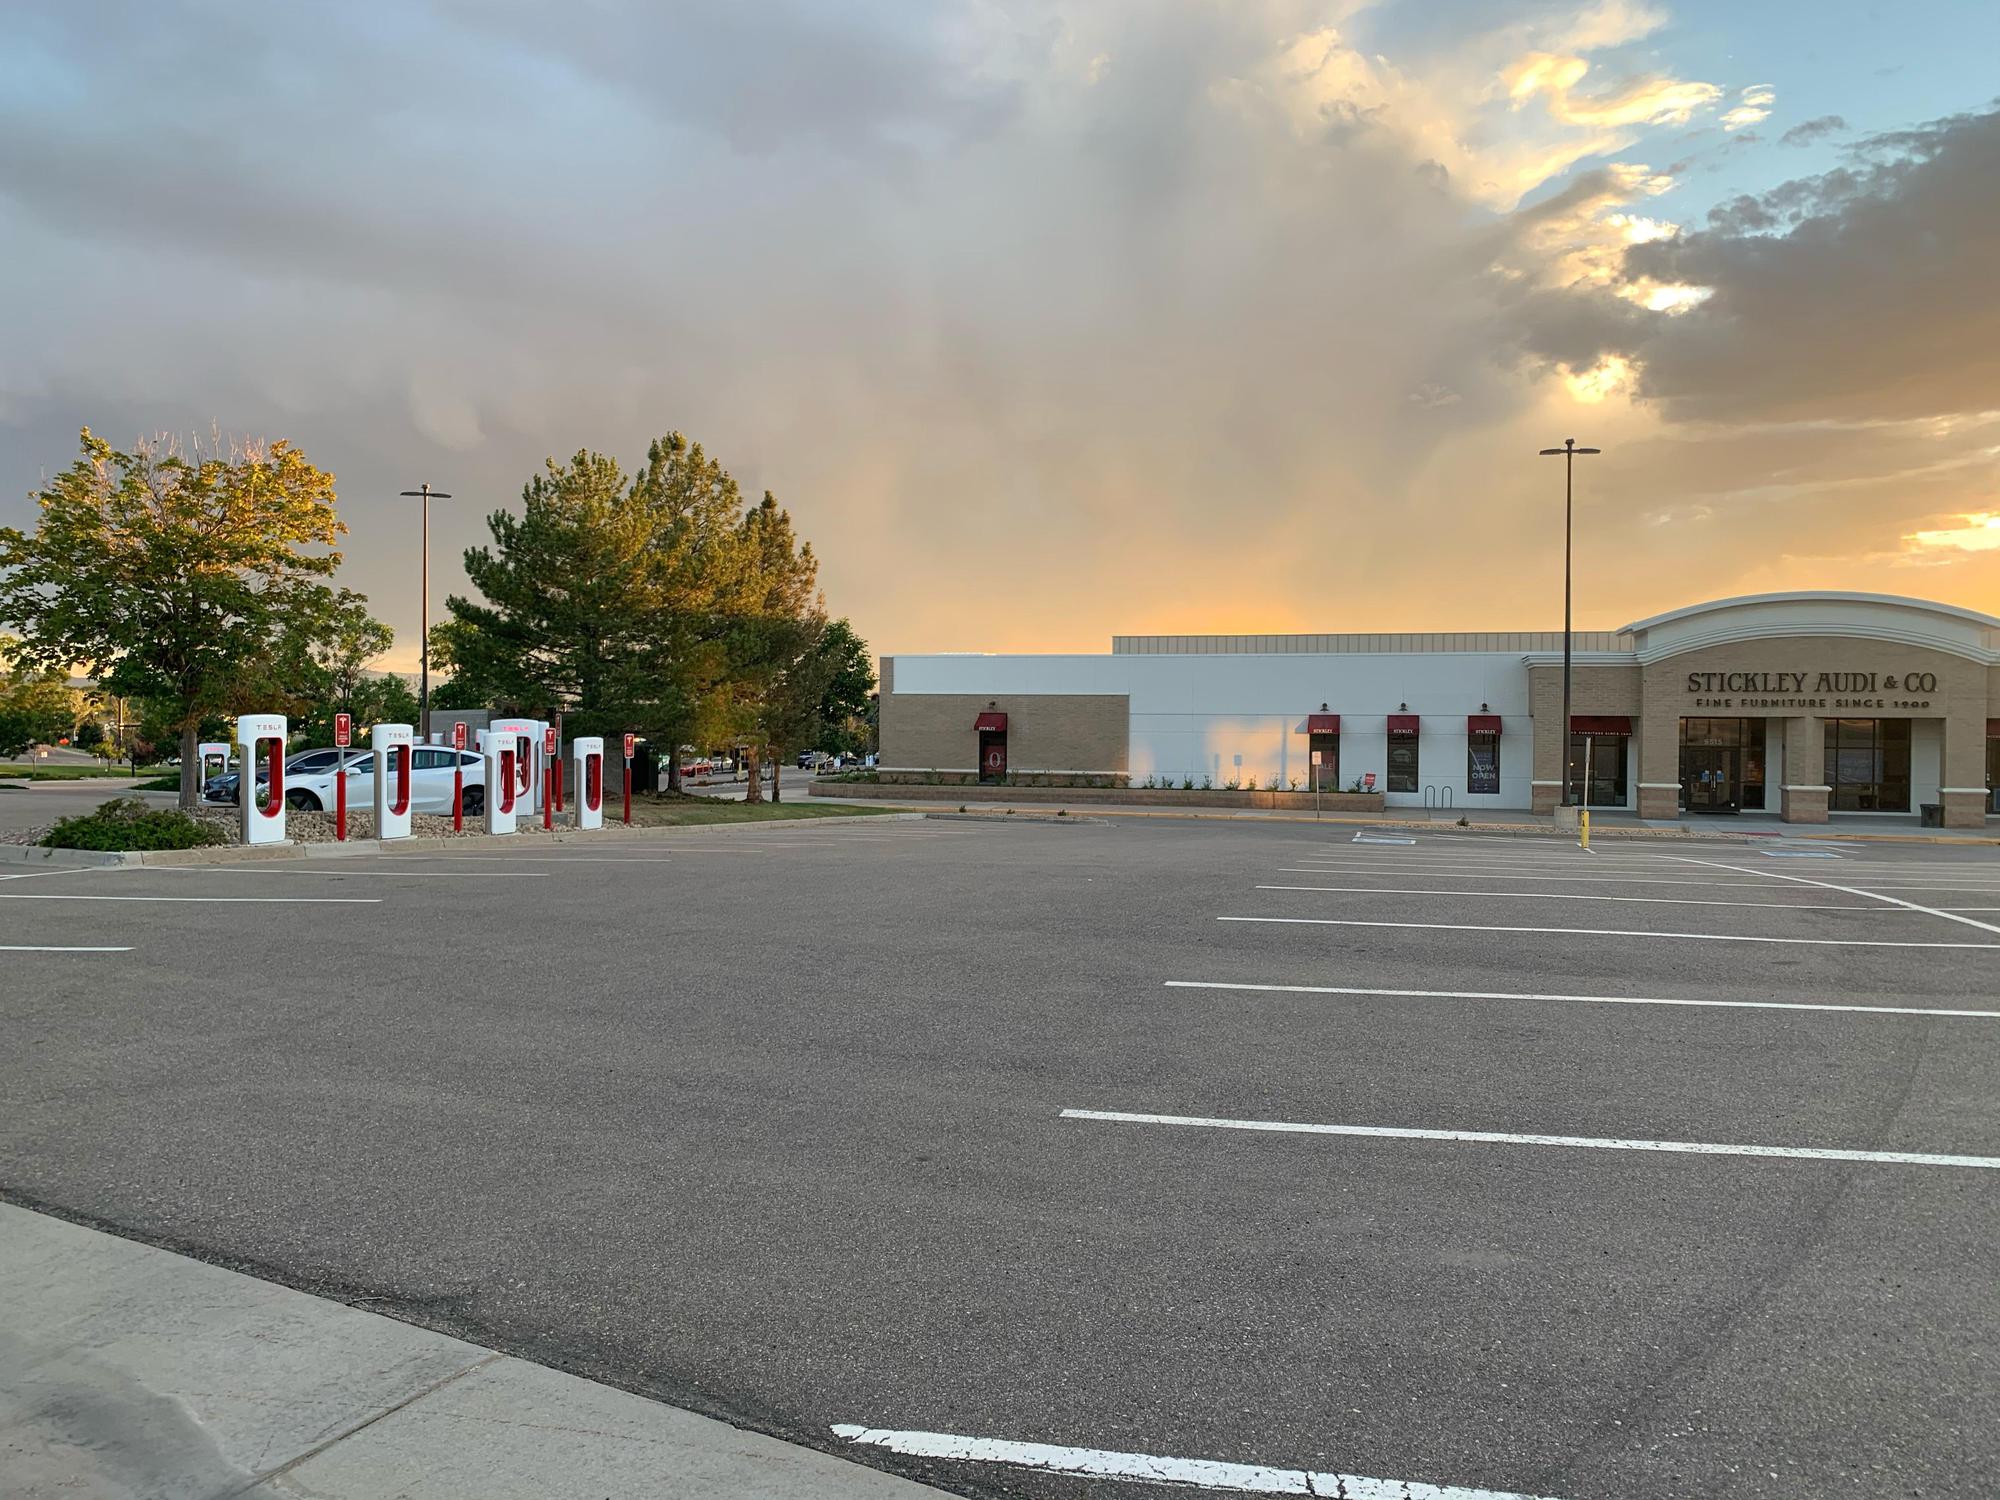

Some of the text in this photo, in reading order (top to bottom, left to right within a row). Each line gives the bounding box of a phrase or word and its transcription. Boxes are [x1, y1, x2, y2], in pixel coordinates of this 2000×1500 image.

[1688, 672, 1808, 692] STICKLEY
[1814, 672, 1878, 692] AUDI
[1883, 675, 1899, 689] &
[1696, 699, 1731, 707] FINE
[1741, 699, 1826, 708] FURNITURE
[1835, 699, 1884, 708] SINCE
